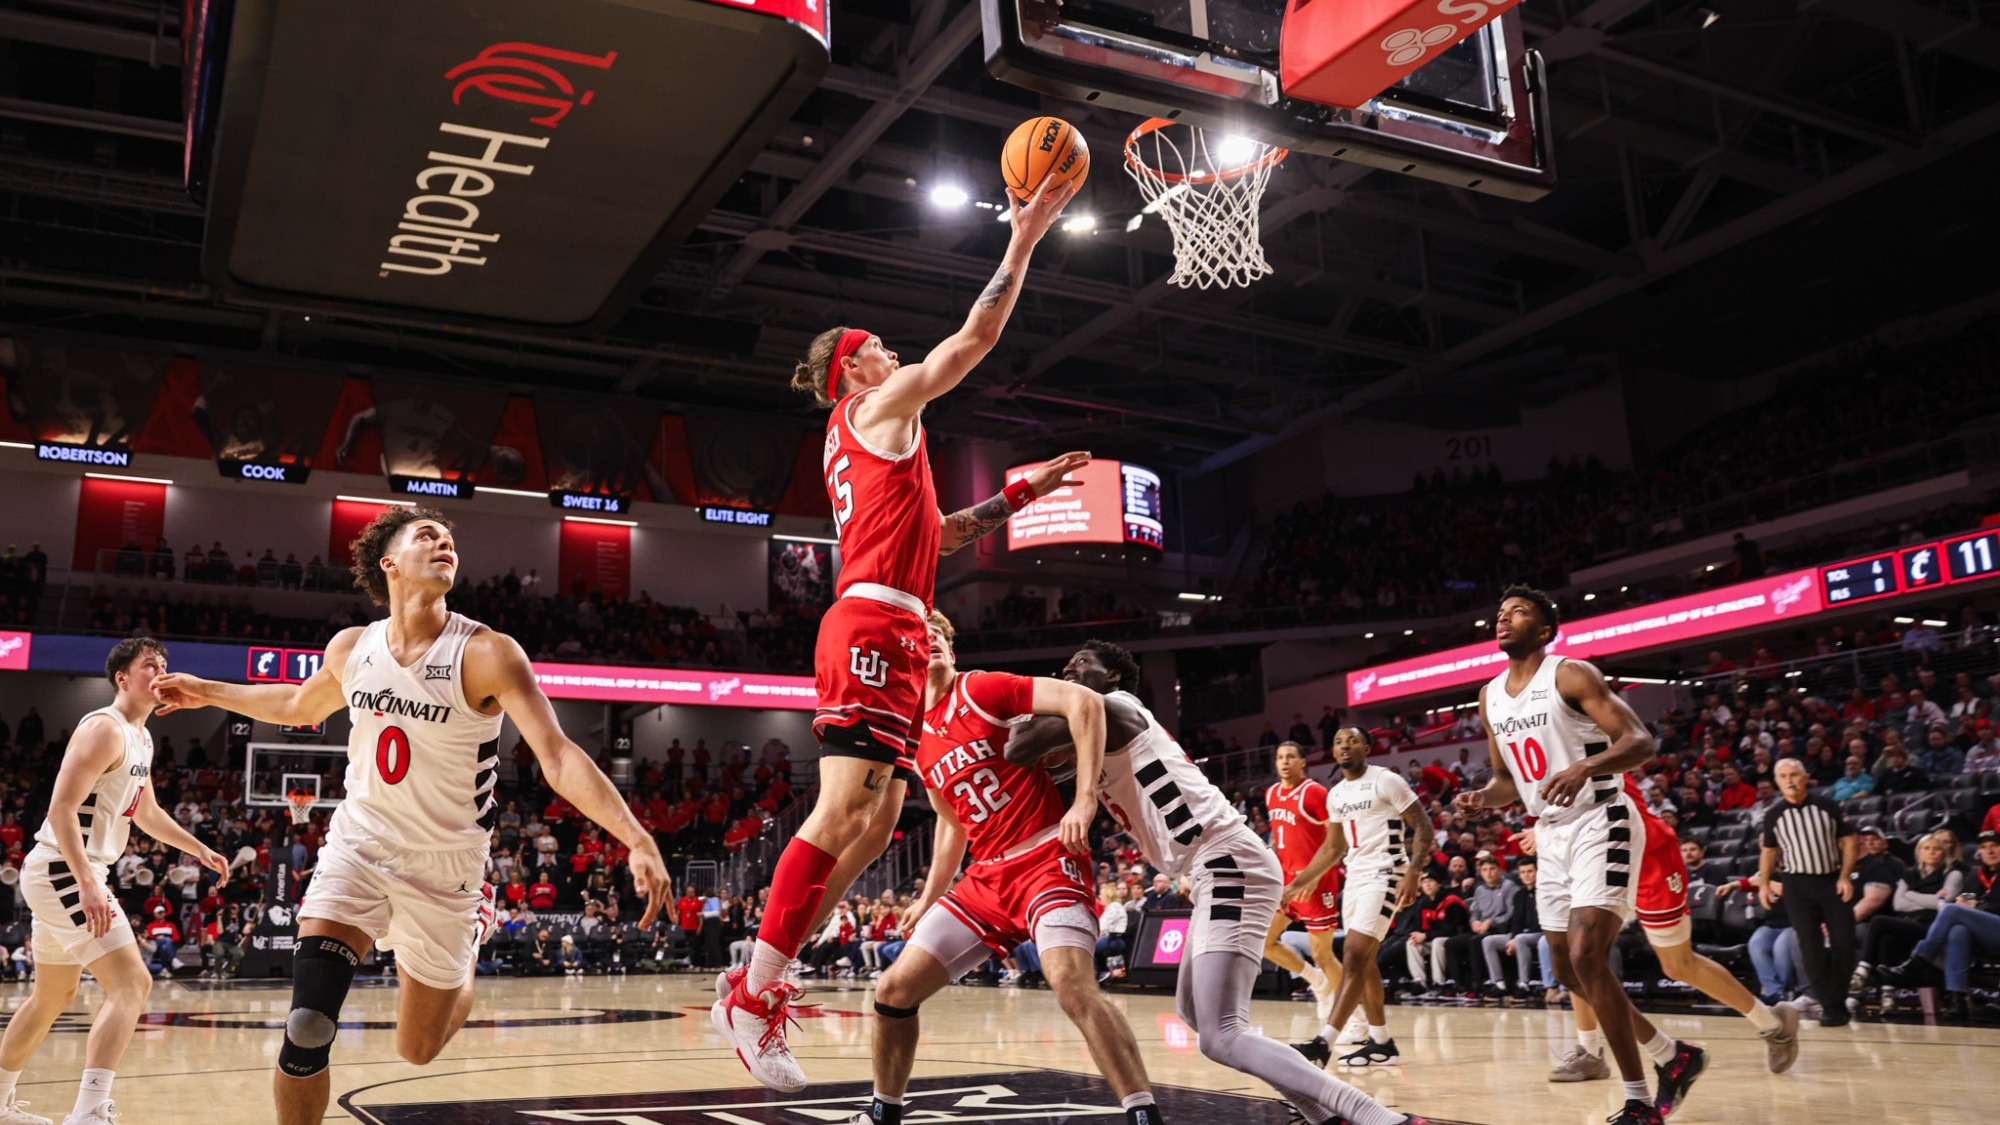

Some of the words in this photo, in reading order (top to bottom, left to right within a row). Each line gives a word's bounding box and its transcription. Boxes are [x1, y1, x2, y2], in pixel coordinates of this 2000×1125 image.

[1040, 119, 1063, 153] NCAA
[381, 122, 550, 275] Health
[38, 445, 128, 466] ROBERTSON
[1446, 435, 1491, 459] 201
[241, 463, 286, 480] COOK
[406, 480, 458, 497] MARTIN
[562, 494, 602, 511] SWEET
[604, 499, 619, 512] 16
[705, 508, 735, 523] ELITE
[735, 511, 770, 526] EIGHT
[1958, 537, 1993, 575] 11
[297, 654, 319, 678] 11
[351, 687, 451, 723] CINCINNATI
[376, 725, 411, 785] 0
[930, 739, 997, 789] UTAH
[1507, 737, 1547, 783] 10
[953, 767, 1012, 823] 32
[1276, 825, 1285, 849] 1
[1349, 820, 1359, 848] 1
[339, 946, 358, 967] cep
